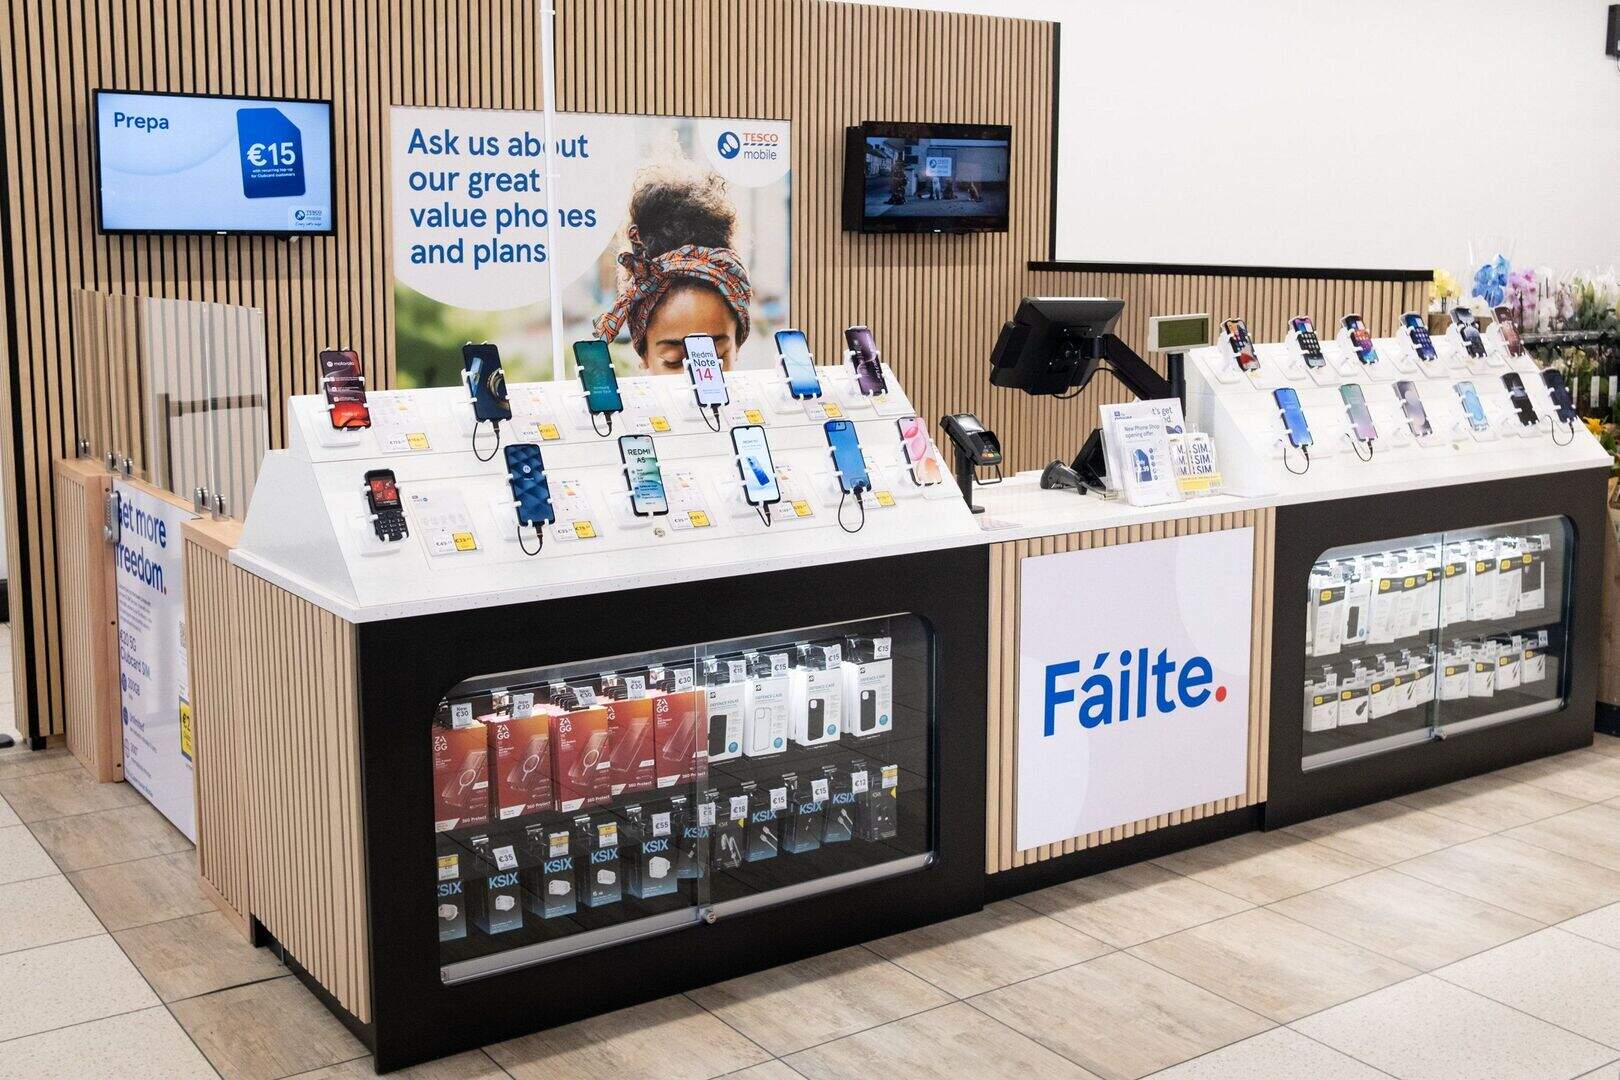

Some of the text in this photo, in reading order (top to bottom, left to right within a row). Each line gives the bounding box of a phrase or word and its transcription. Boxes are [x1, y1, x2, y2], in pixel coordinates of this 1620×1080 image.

[113, 112, 169, 133] Prepa
[408, 128, 460, 155] Ask
[468, 136, 500, 156] us
[743, 132, 779, 143] TESCO
[246, 141, 297, 167] €15
[743, 150, 777, 161] mobile
[409, 168, 541, 199] our great
[410, 201, 487, 228] value
[410, 238, 464, 264] and
[693, 359, 716, 367] Note
[695, 368, 713, 381] 14
[627, 448, 651, 456] REDMI
[136, 508, 167, 548] more
[1043, 647, 1227, 737] Fáilte.
[832, 792, 856, 804] KSIX
[800, 800, 823, 815] KSIX
[752, 809, 777, 823] KSIX
[684, 827, 709, 839] KSIX
[642, 838, 669, 854] KSIX
[498, 853, 514, 863] €35
[591, 848, 619, 864] KSIX
[543, 857, 573, 874] KSIX
[489, 871, 519, 889] KSIX
